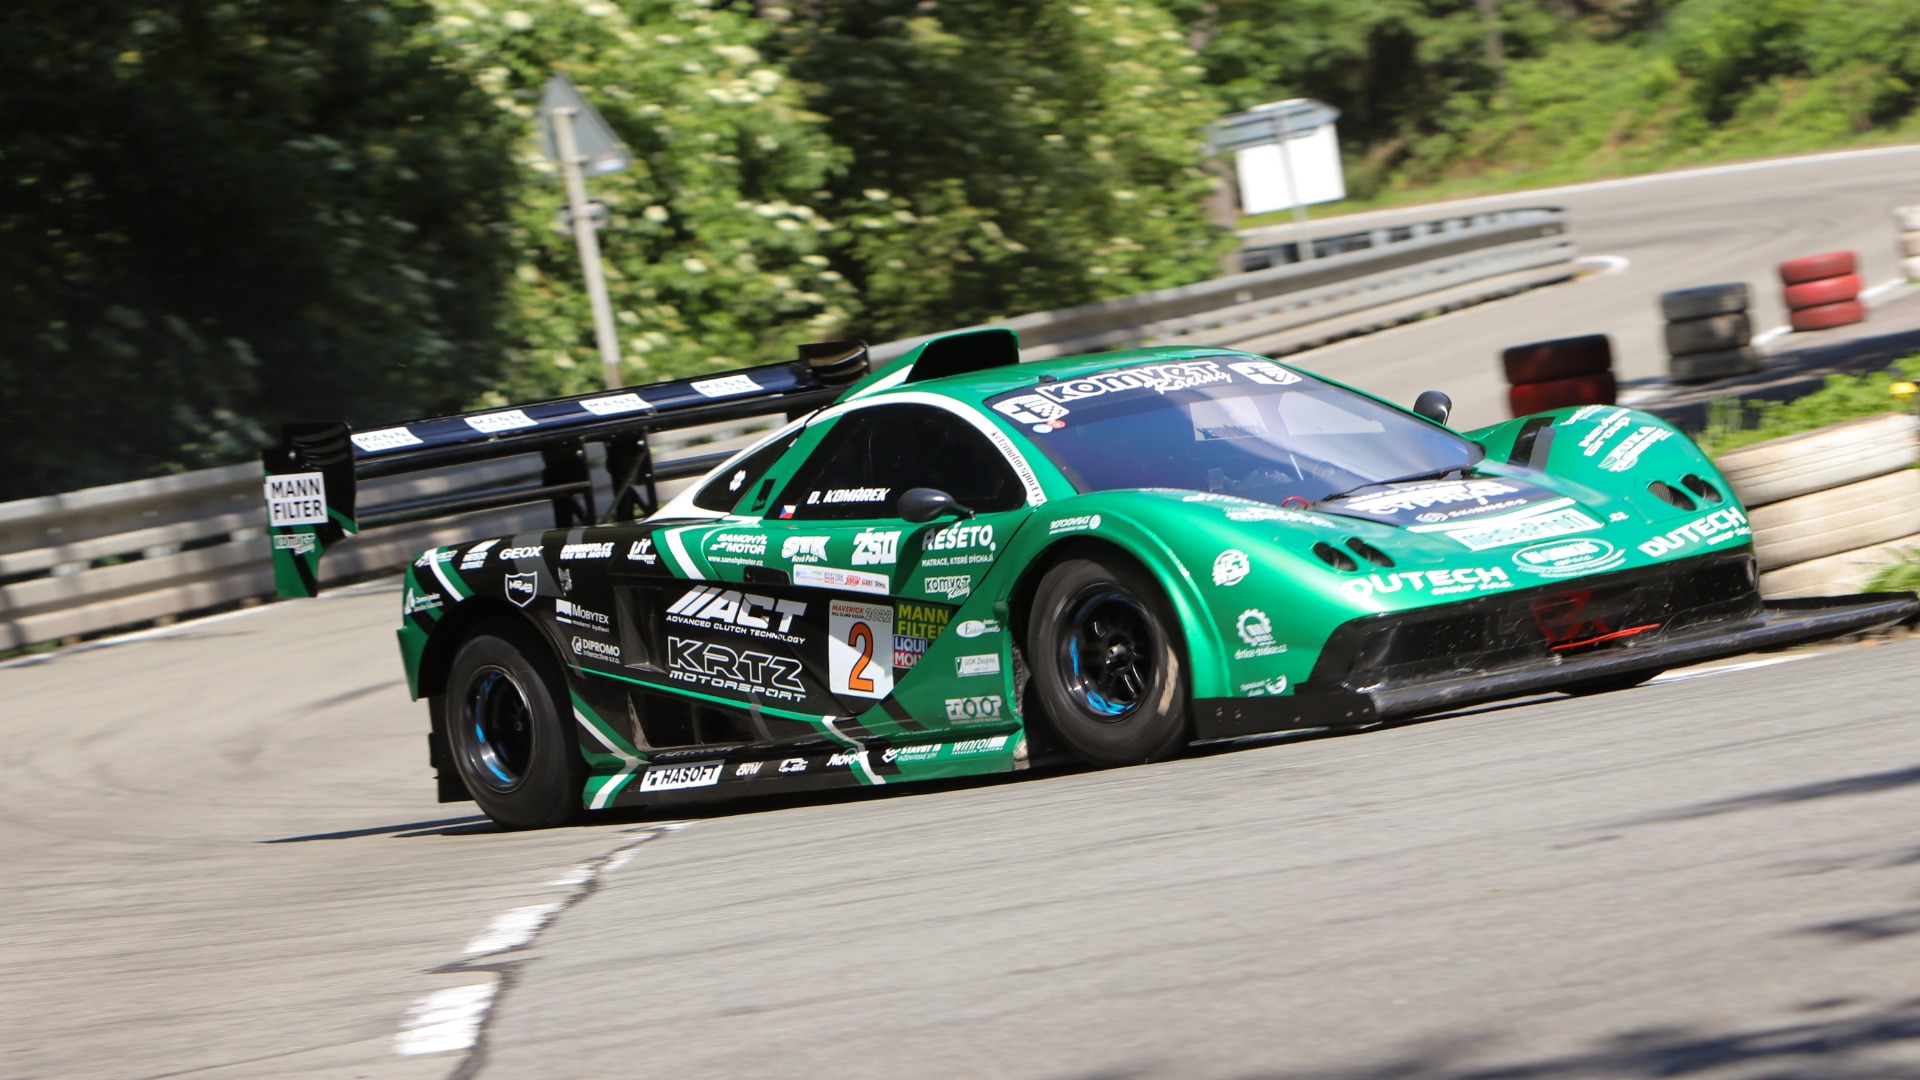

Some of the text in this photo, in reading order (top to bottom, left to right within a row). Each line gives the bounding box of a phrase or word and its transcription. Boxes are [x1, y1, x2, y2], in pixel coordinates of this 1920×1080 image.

[699, 379, 747, 389] MANN
[1144, 370, 1232, 394] Racing
[588, 398, 637, 408] MANN
[472, 414, 522, 425] MANN
[356, 431, 407, 443] MANN
[364, 437, 413, 449] FILTER
[271, 478, 321, 499] MANN
[806, 486, 890, 505] D. KOMÁREK
[274, 499, 324, 520] FILTER
[717, 533, 768, 546] SAMOHÝL
[1637, 506, 1747, 558] DUTECH
[499, 546, 544, 560] GEOX
[587, 551, 612, 559] MOTO
[726, 542, 766, 555] MOTOR
[707, 554, 764, 567] www.samohylmotor.cz
[921, 553, 994, 568] MATRACE, KTERÉ DÝCHAJÍ
[1339, 566, 1510, 600] DUTECH
[1431, 584, 1476, 596] GROUP
[947, 586, 971, 600] Racing
[831, 604, 892, 623] MAVERICK 2022
[899, 604, 949, 625] MANN
[665, 615, 806, 645] ADVANCED CLUTCH TECHNOLOGY
[582, 638, 620, 657] DIPROMO
[894, 636, 926, 653] LIQUI
[667, 636, 807, 693] KRTZ
[848, 621, 875, 693] 2
[668, 670, 807, 702] MOTORSPORT
[900, 743, 942, 755] STAVBY IS
[952, 737, 992, 752] winrol
[661, 765, 722, 786] HASOFT
